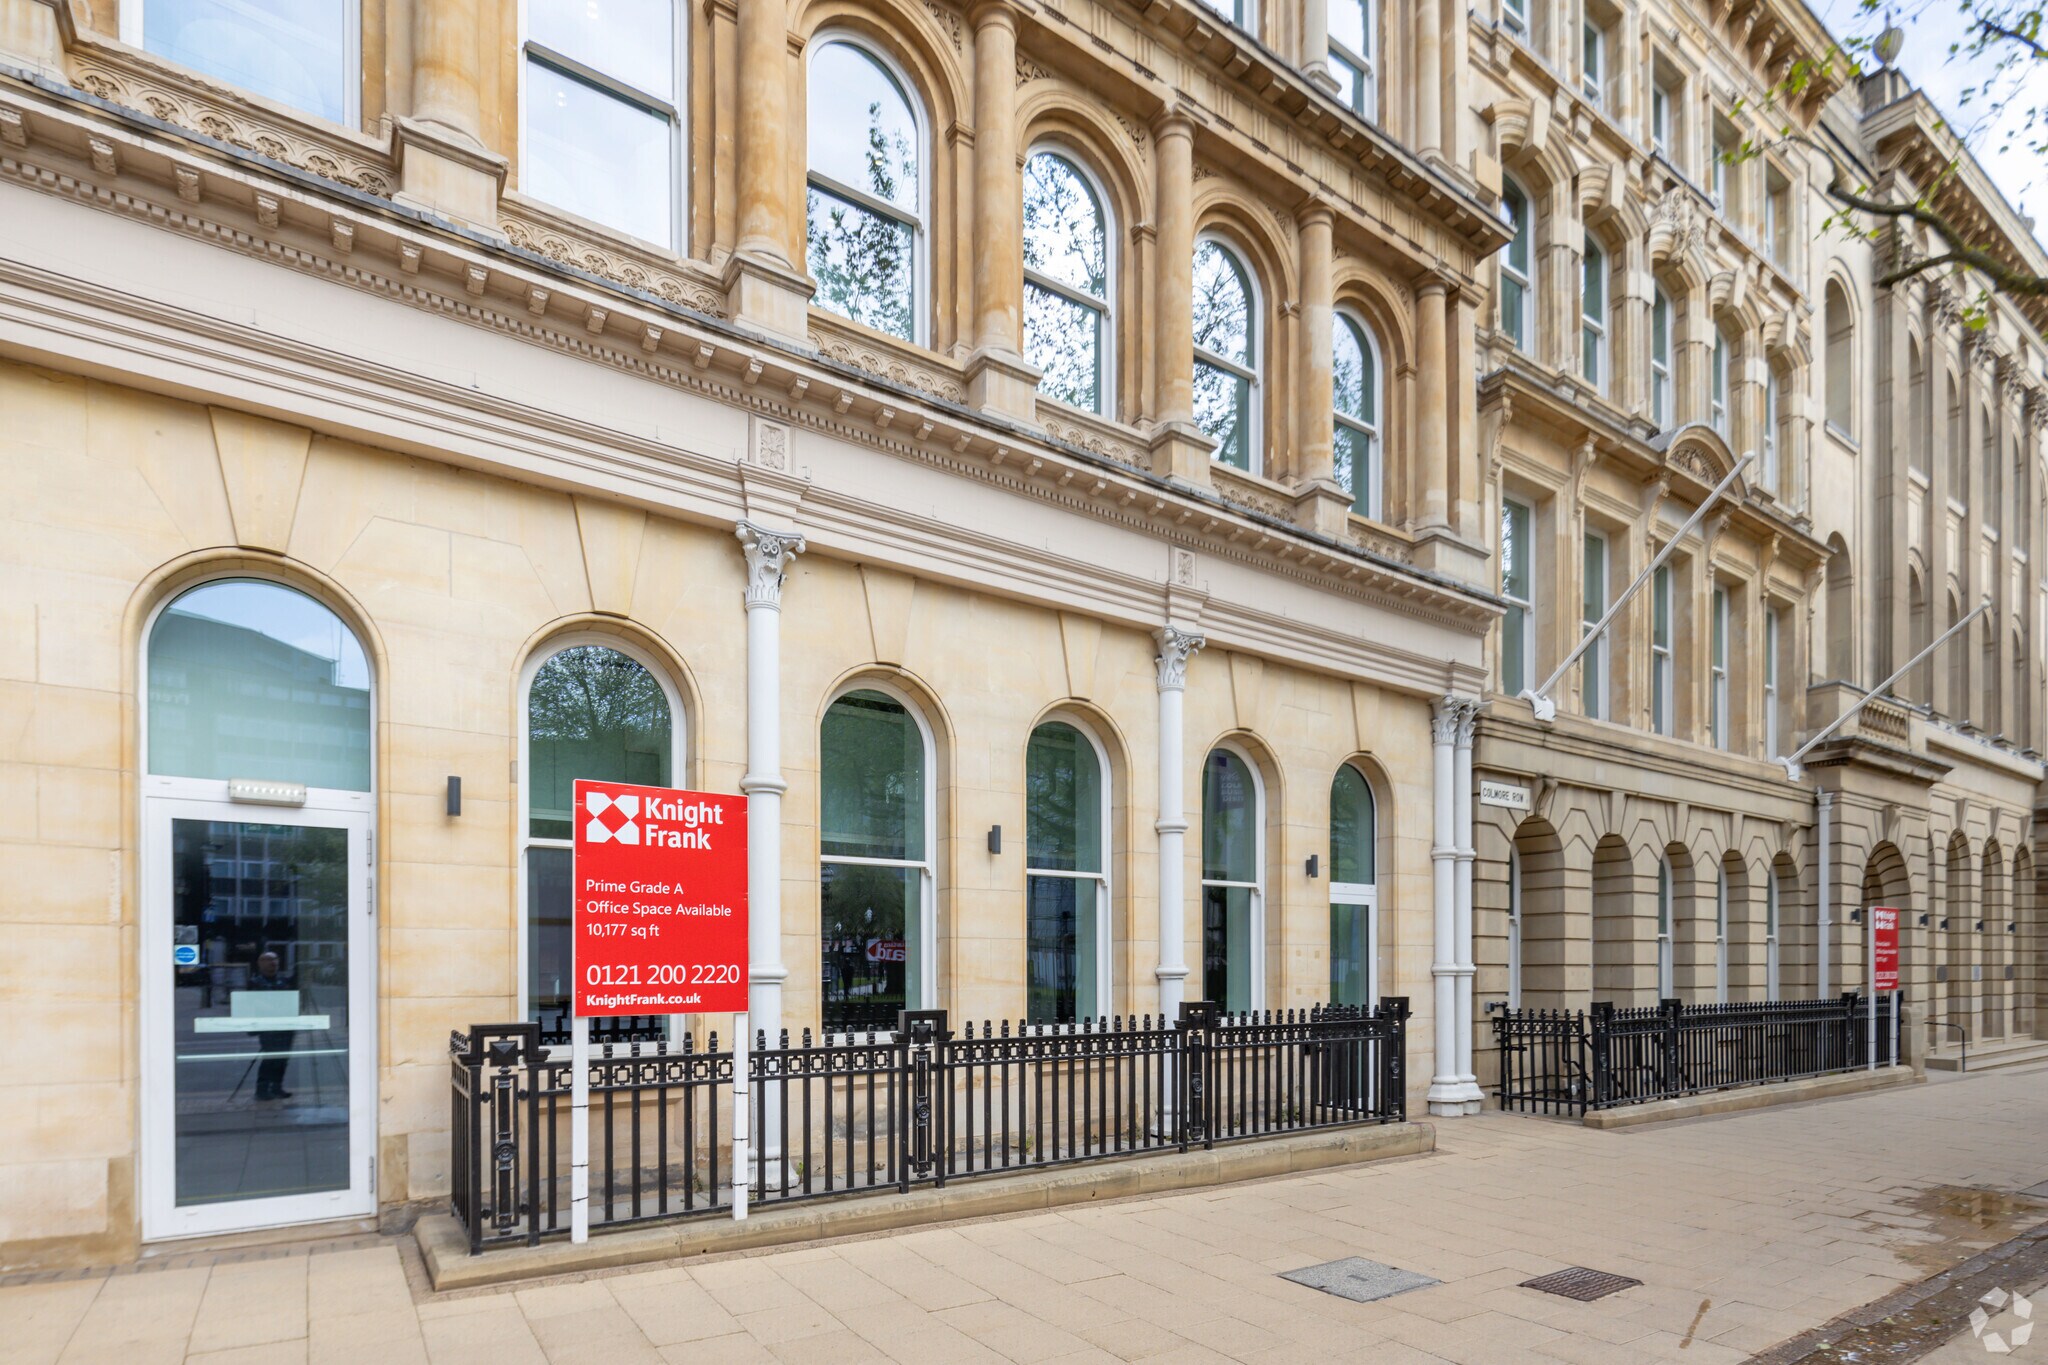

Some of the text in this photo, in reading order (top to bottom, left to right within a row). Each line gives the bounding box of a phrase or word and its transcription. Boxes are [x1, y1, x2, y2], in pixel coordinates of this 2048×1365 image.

[1482, 787, 1524, 802] COLMORE ROW
[645, 796, 723, 828] Knight
[645, 824, 712, 850] Frank
[586, 879, 684, 895] Prime Grade A
[586, 901, 732, 918] Office Space Available
[586, 923, 660, 940] 10,177 sq ft
[586, 964, 740, 986] 0121 200 2220
[586, 993, 701, 1009] KnightFrank.co.uk
